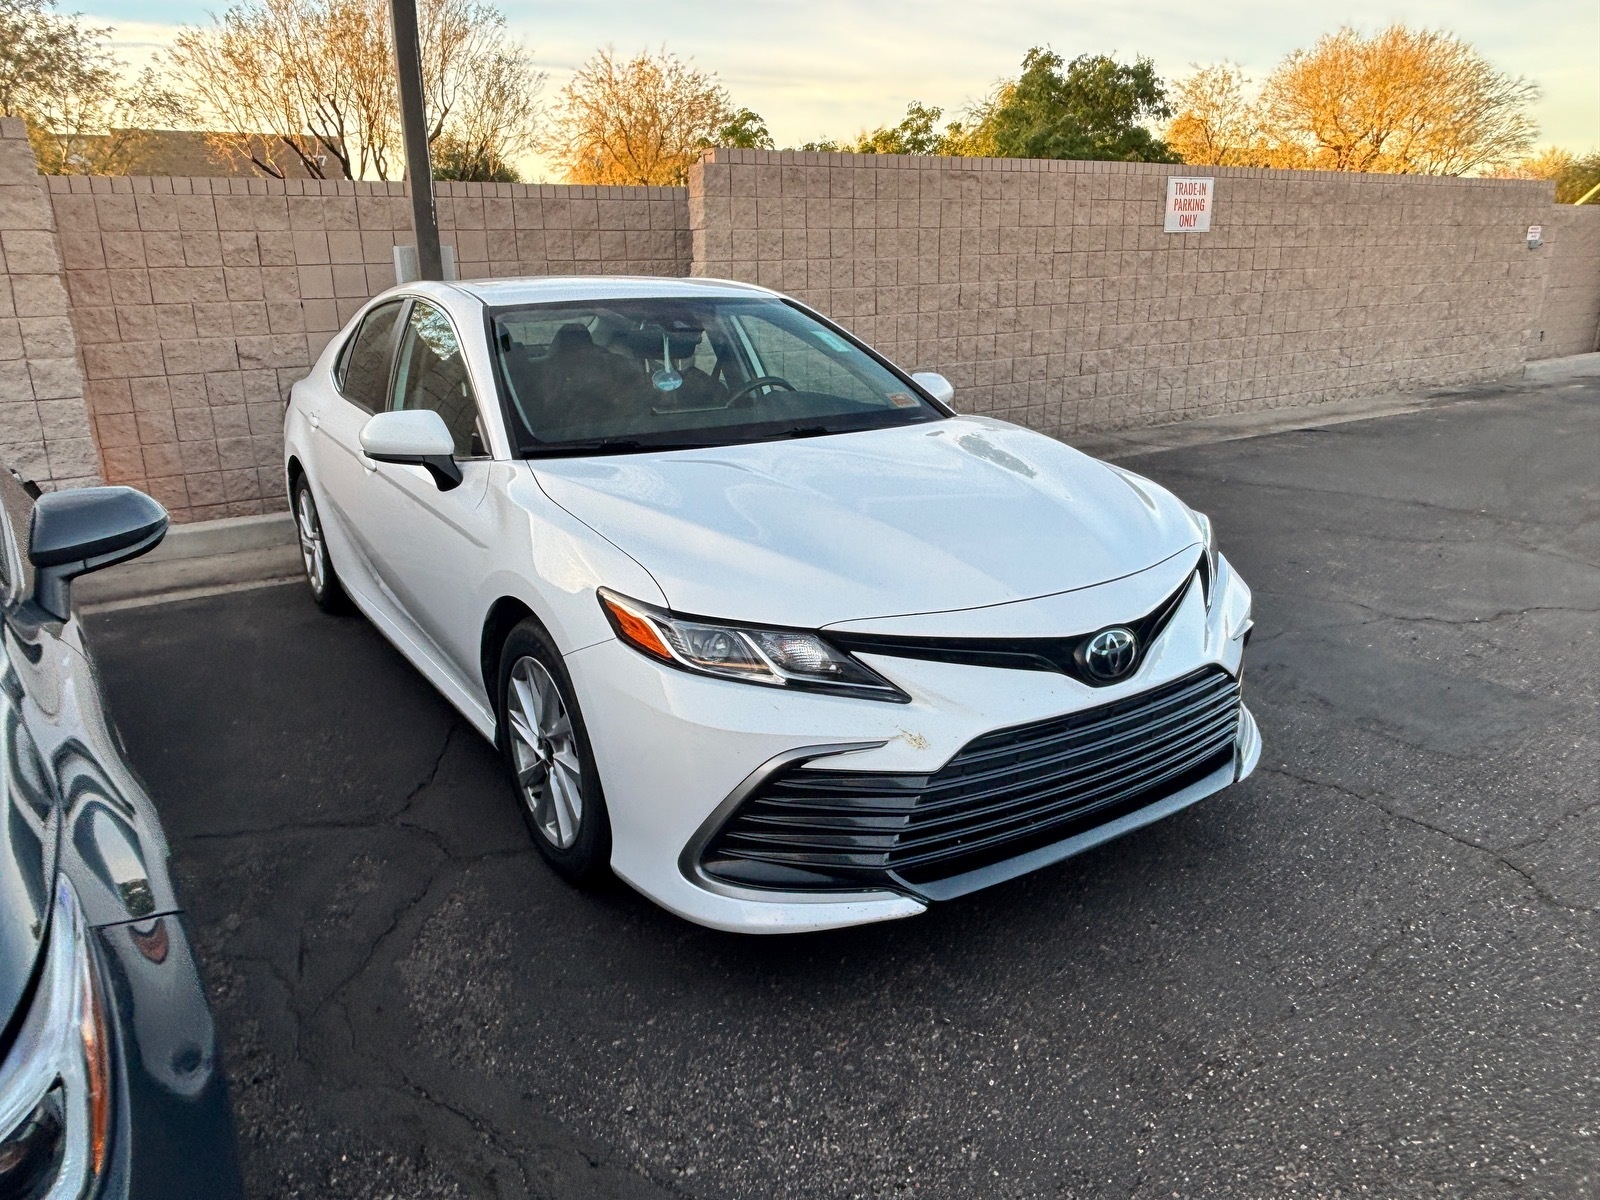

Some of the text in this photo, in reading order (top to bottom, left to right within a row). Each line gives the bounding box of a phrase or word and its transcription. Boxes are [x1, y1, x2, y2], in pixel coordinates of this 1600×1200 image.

[1175, 182, 1207, 195] TRADE-IN
[1174, 198, 1205, 211] PARKING
[1179, 214, 1198, 227] ONLY
